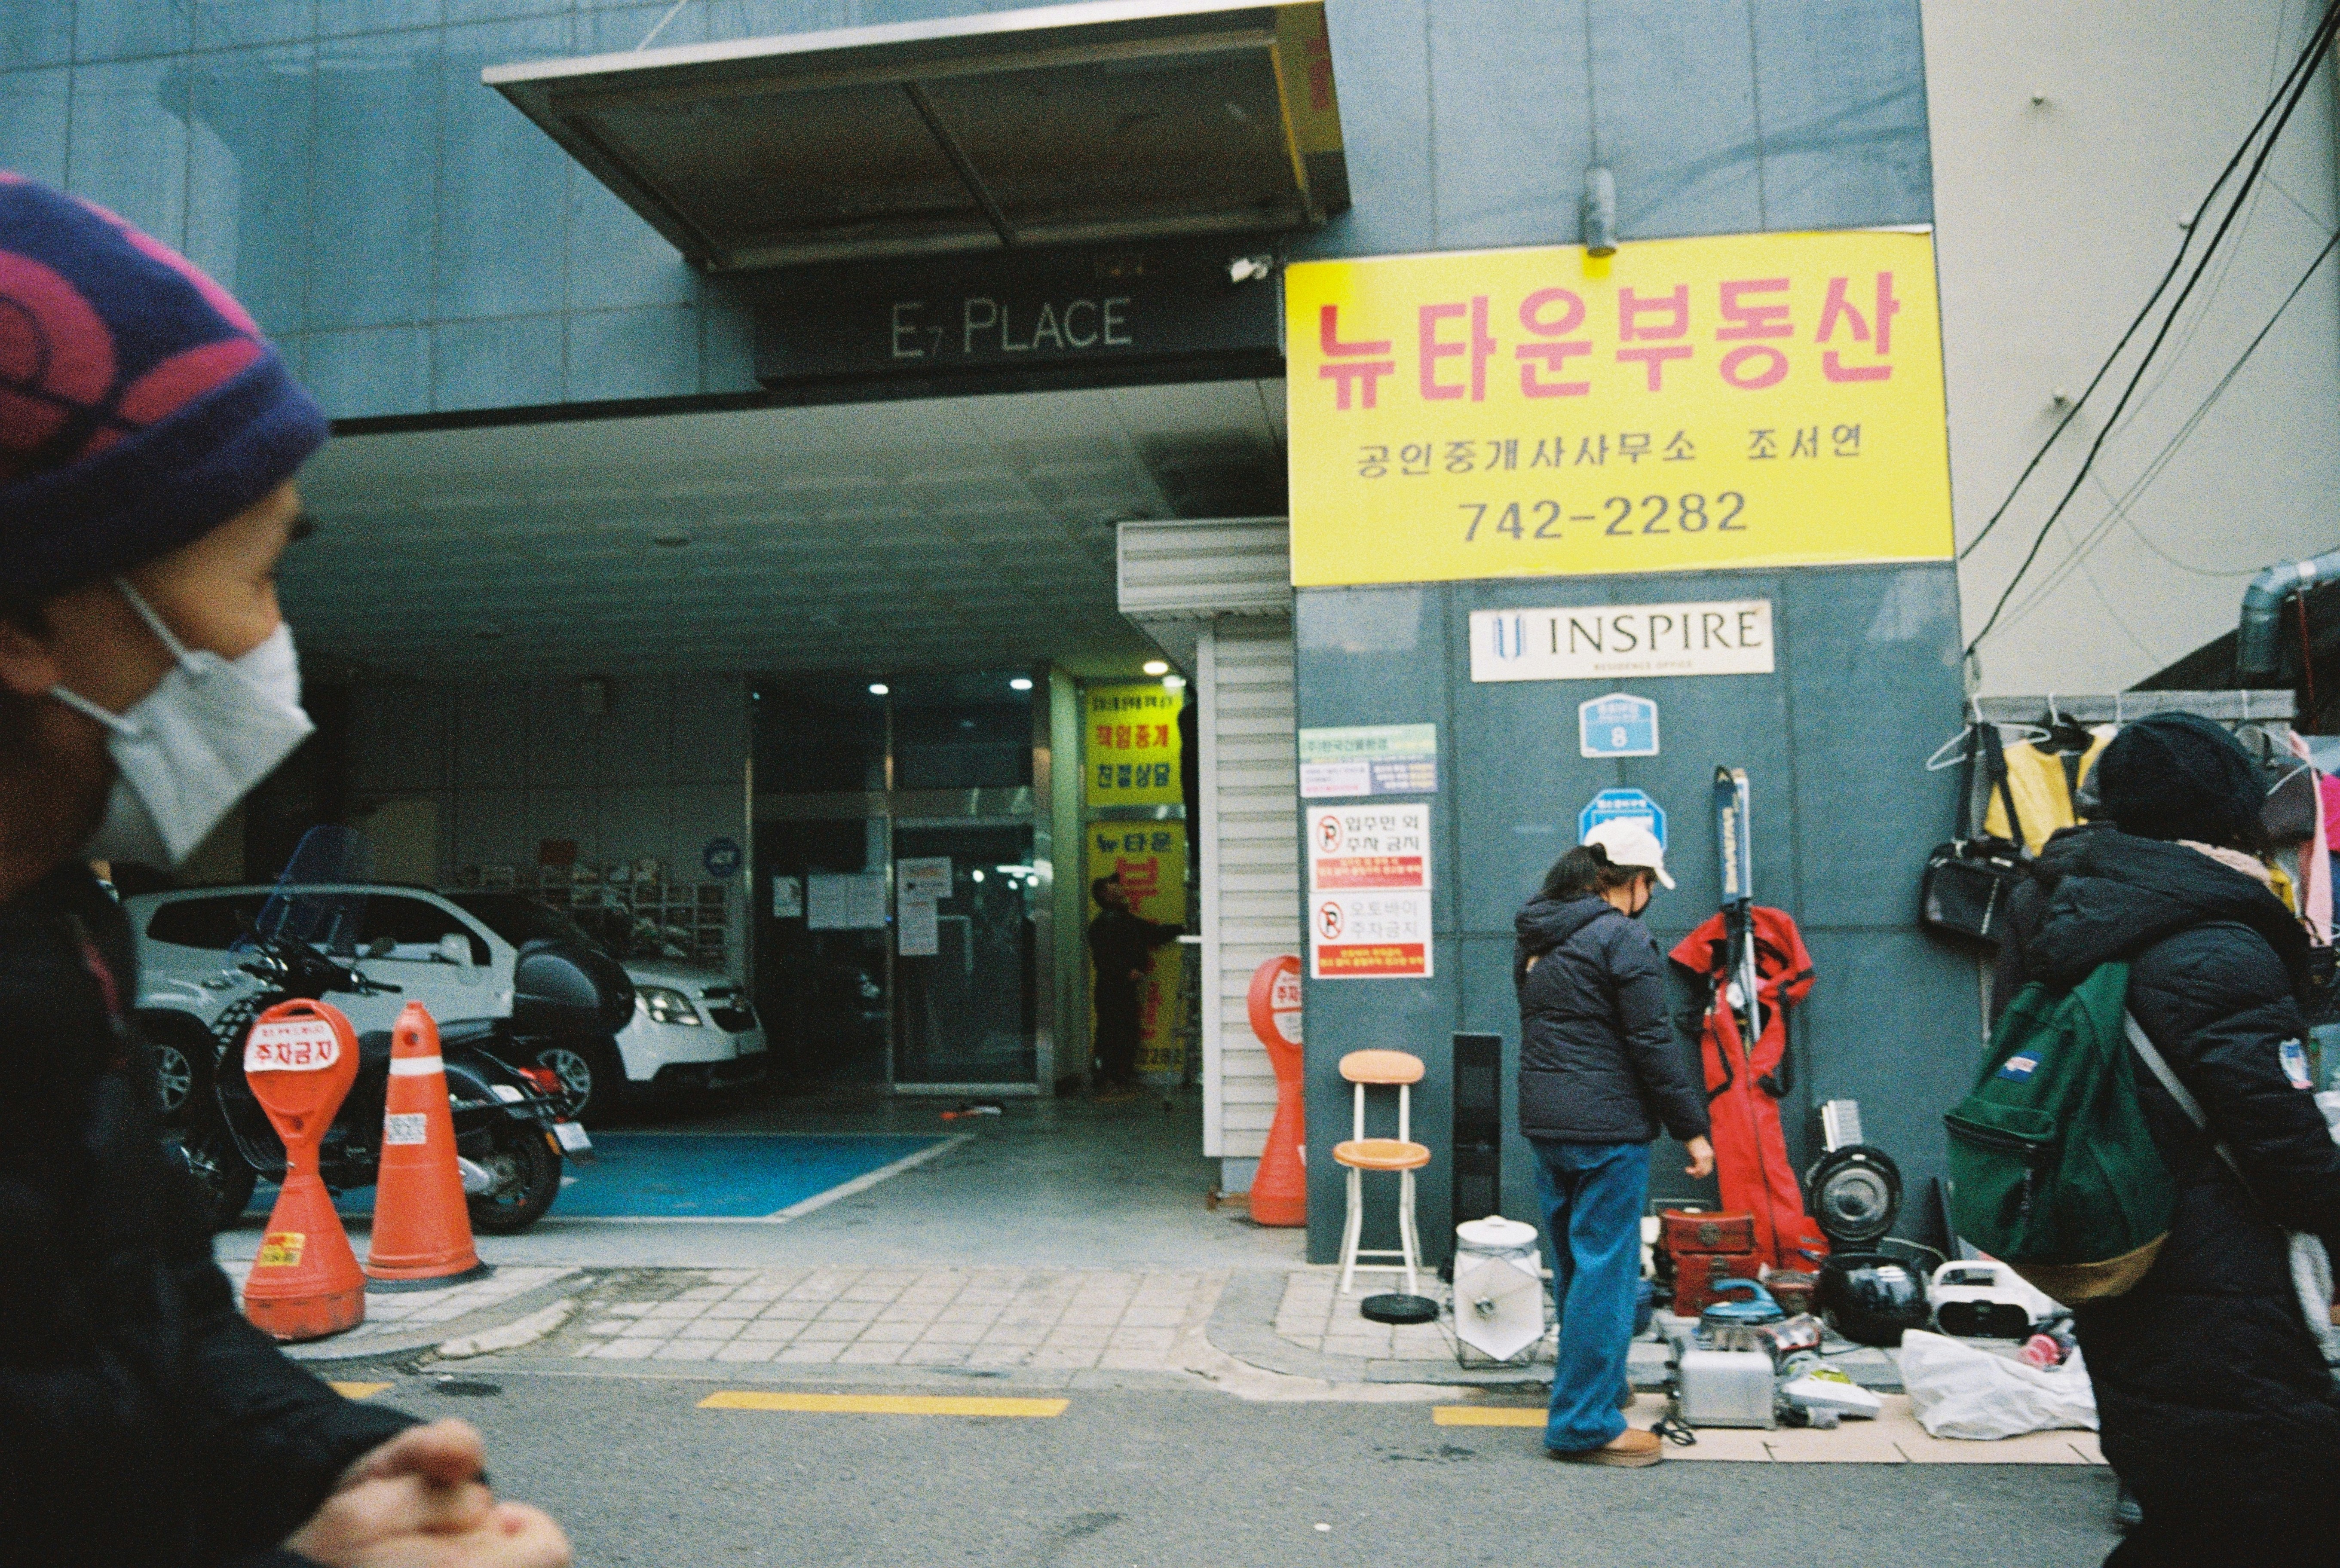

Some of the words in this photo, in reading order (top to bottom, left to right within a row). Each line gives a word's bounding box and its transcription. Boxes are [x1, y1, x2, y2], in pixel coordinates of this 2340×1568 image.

[963, 296, 1133, 353] PLACE
[1319, 271, 1901, 411] 뉴타운부동산
[1357, 429, 1698, 480] 공인중개사사무소
[1748, 422, 1863, 461] 조서연
[1458, 491, 1748, 543] 742-2282
[1549, 611, 1763, 654] INSPIRE
[1611, 726, 1628, 748] 8
[1096, 832, 1172, 853] 뉴타운
[1350, 899, 1418, 916] 오토바이
[1351, 920, 1418, 938] 주차금지
[255, 1040, 332, 1066] 주차금지
